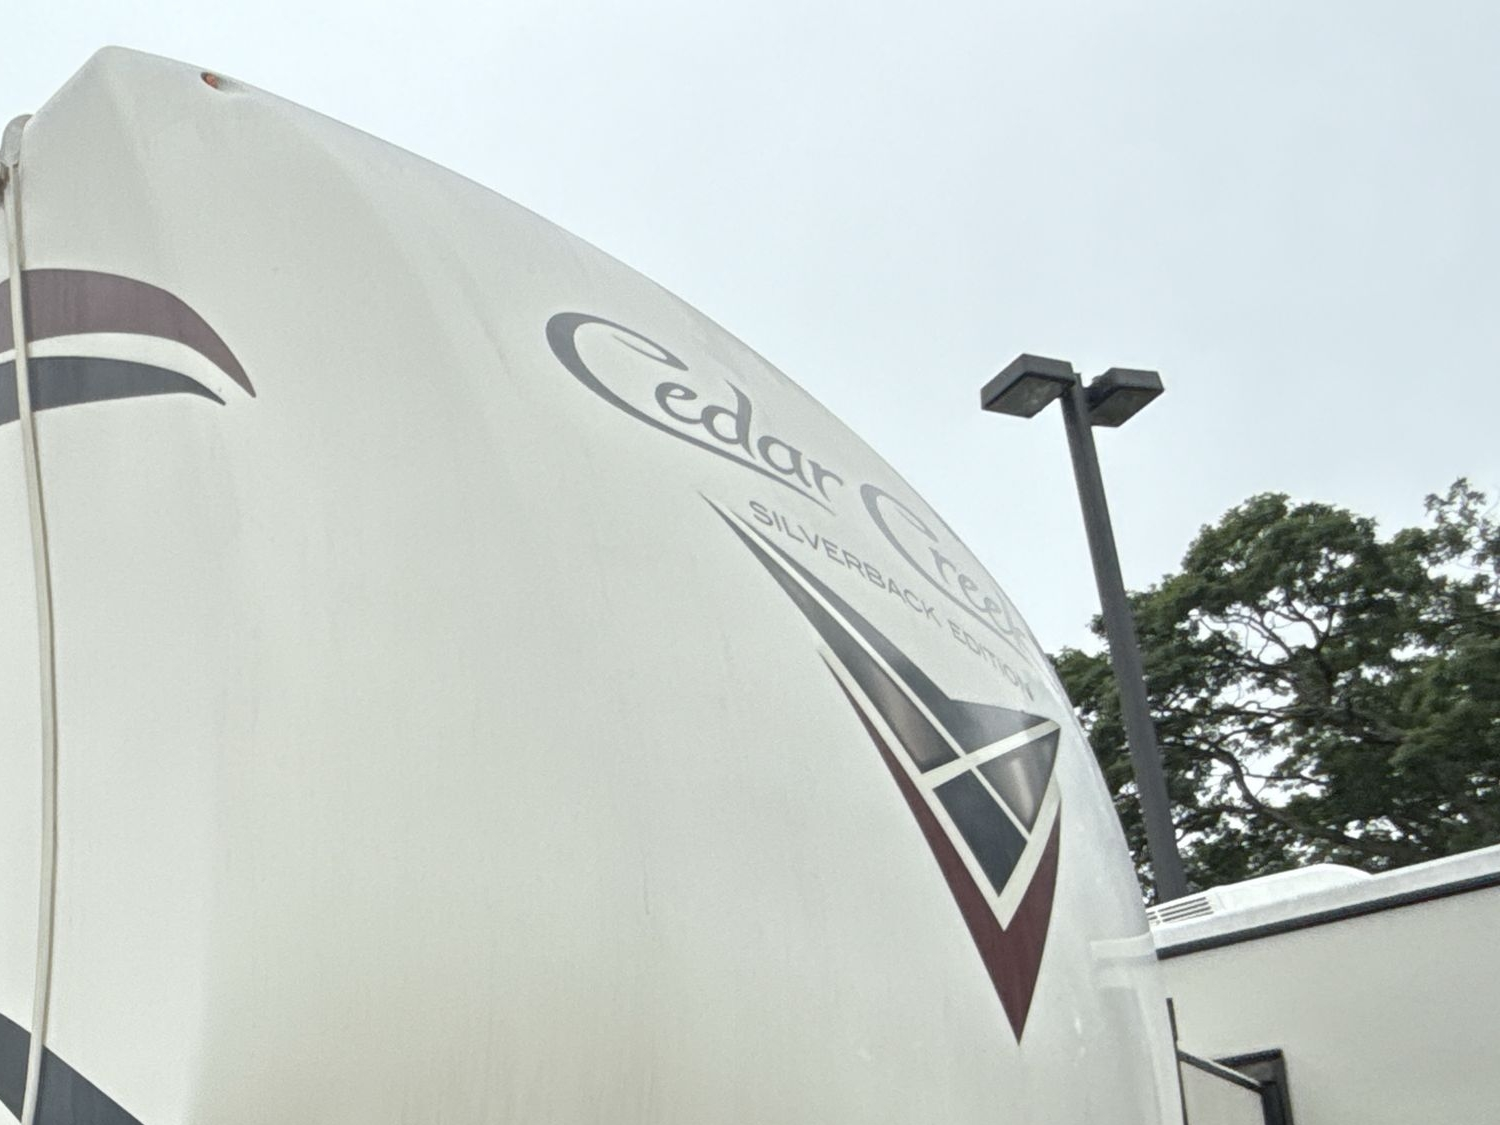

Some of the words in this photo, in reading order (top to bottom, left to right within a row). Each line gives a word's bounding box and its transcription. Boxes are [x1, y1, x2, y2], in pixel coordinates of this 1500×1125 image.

[545, 311, 844, 516] Cedar
[859, 483, 1040, 672] Creek
[748, 499, 942, 628] SILVERBACK
[947, 618, 1035, 702] EDITION
